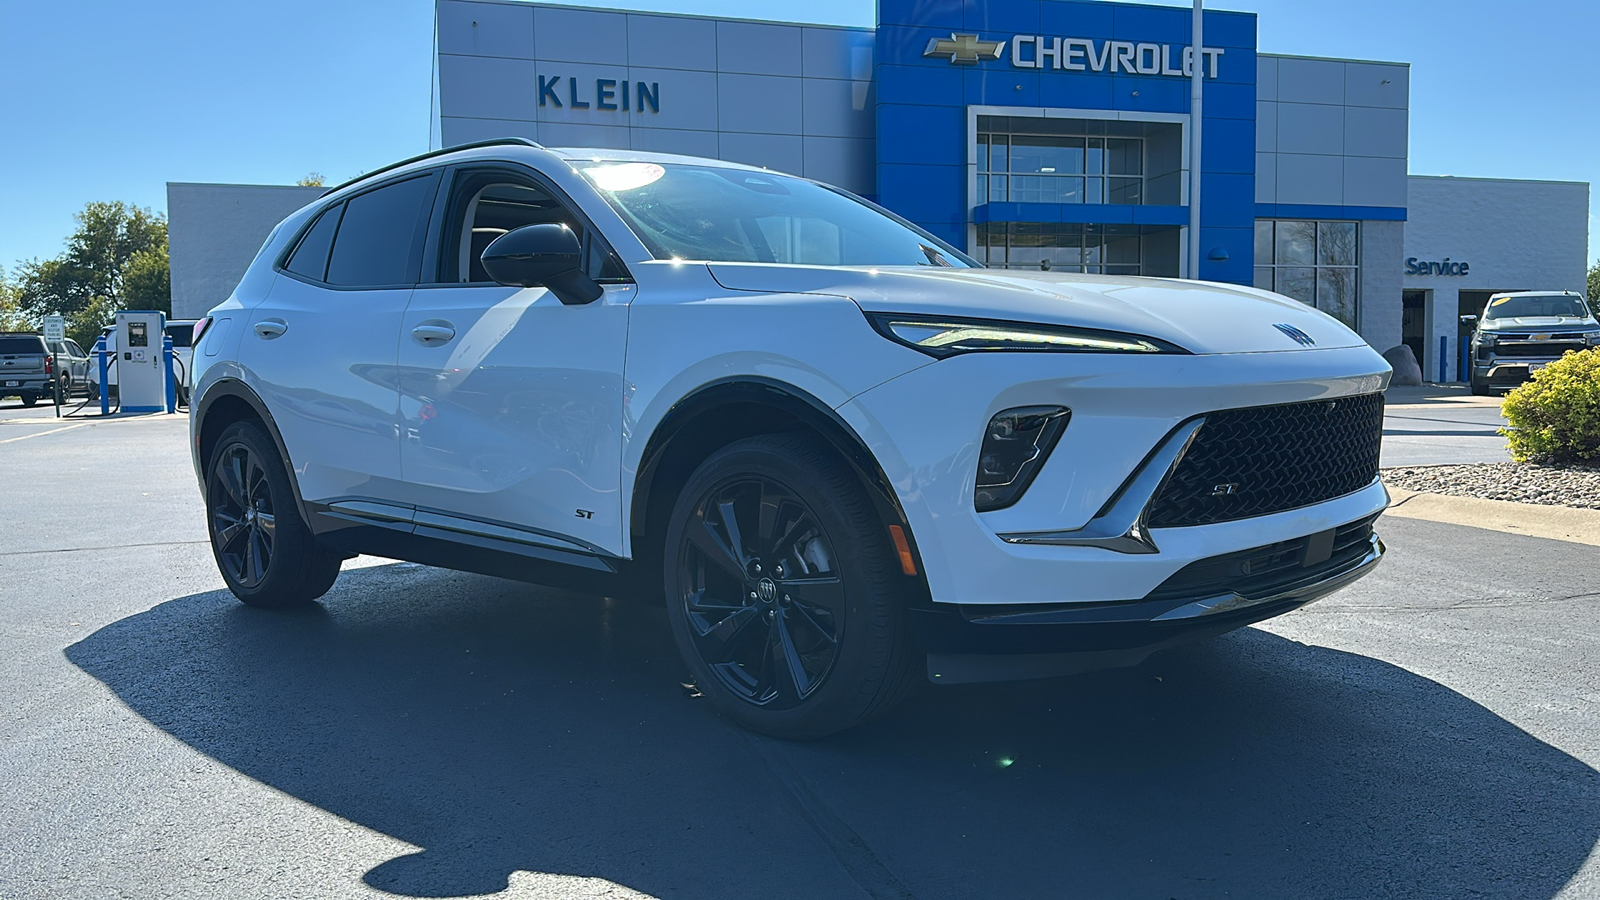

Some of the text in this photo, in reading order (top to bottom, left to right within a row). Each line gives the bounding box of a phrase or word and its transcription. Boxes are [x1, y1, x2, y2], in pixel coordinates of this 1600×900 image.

[538, 74, 660, 113] KLEIN
[1405, 257, 1469, 276] Service
[575, 508, 595, 520] ST
